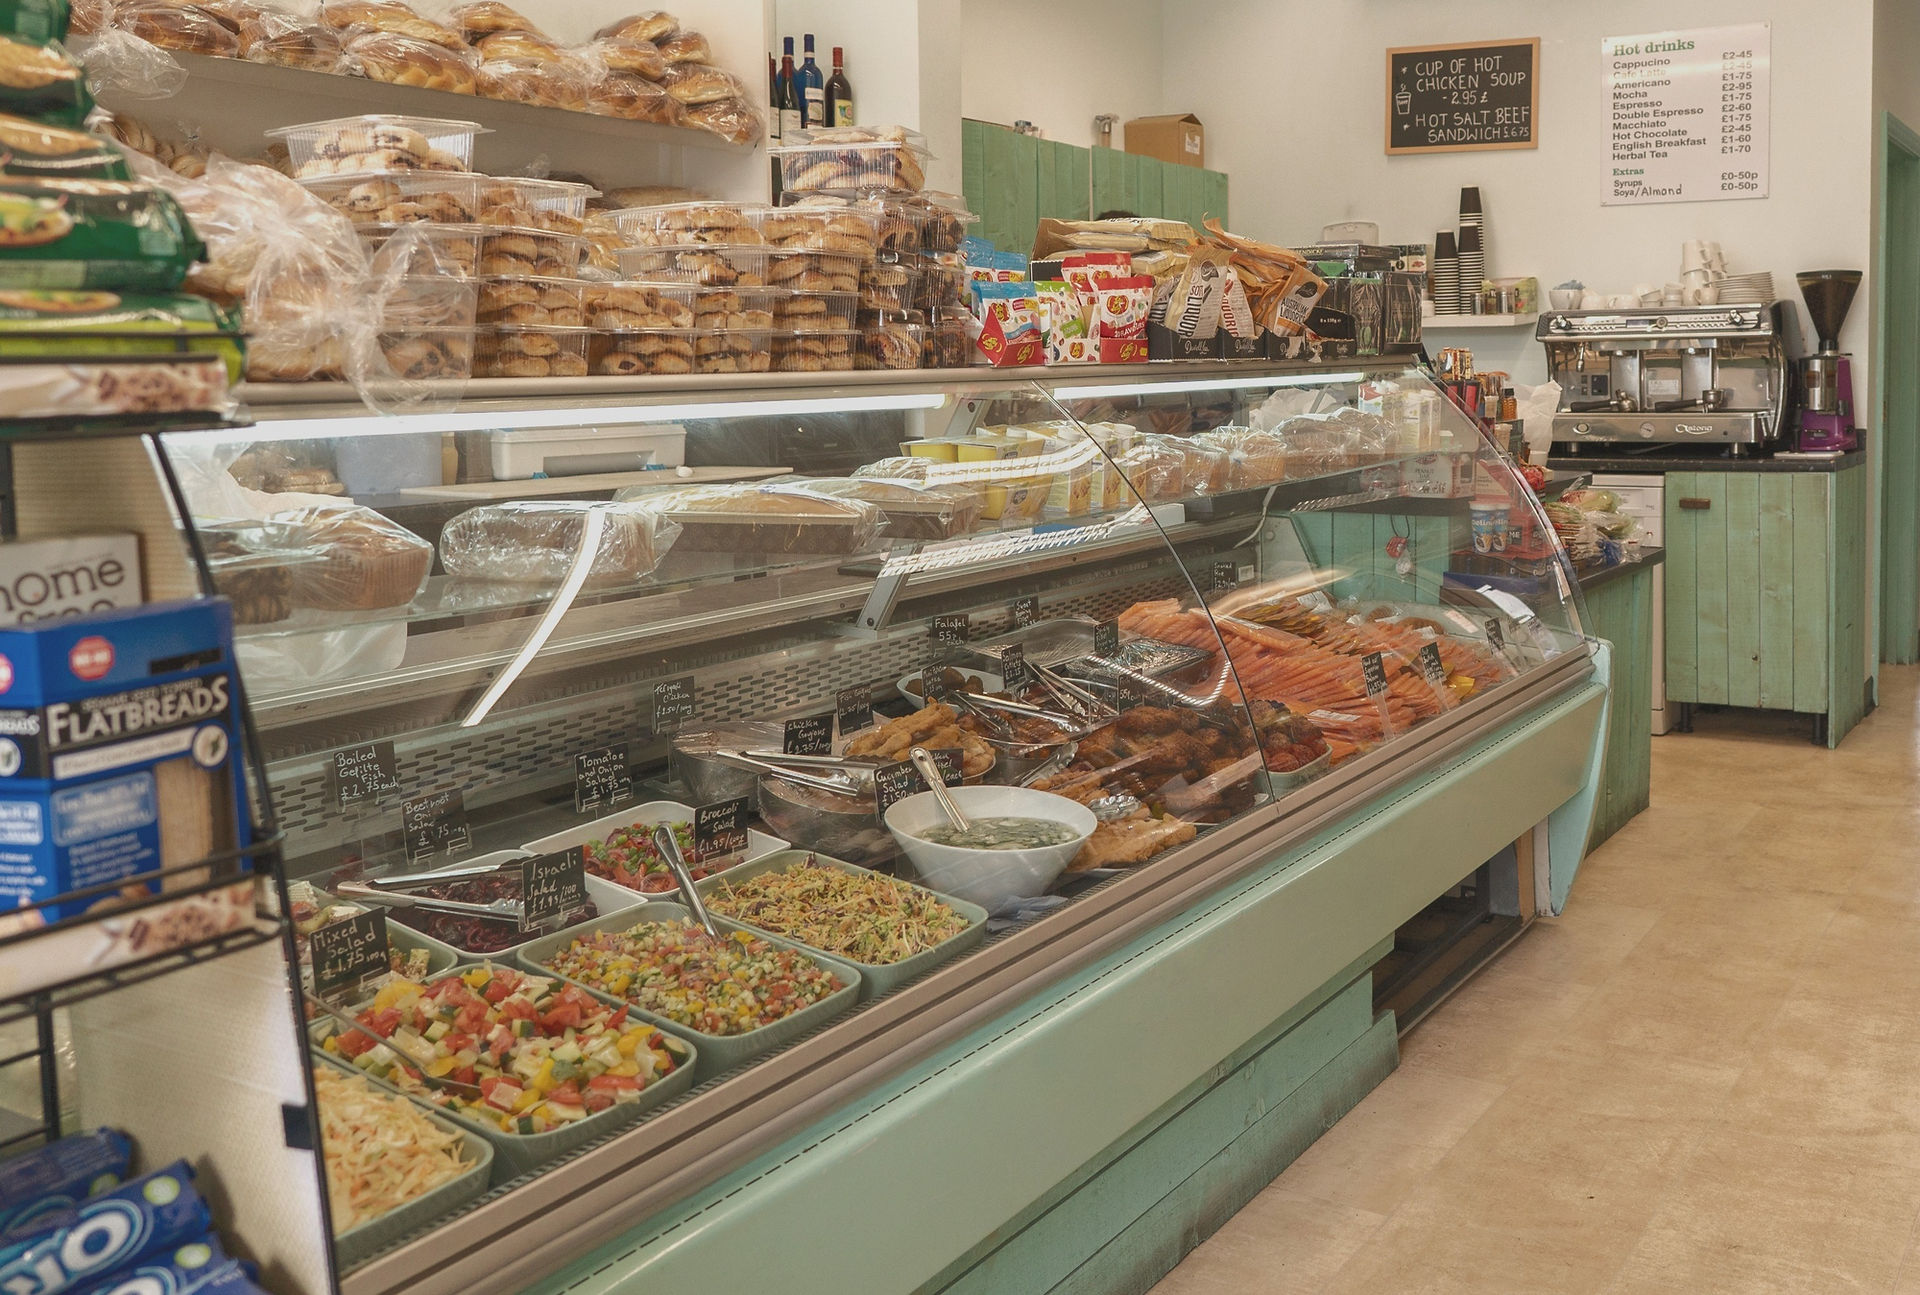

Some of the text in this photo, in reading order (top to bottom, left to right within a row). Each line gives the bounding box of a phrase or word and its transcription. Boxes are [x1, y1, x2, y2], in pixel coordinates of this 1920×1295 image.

[1613, 39, 1695, 57] Hot drinks
[1415, 56, 1502, 76] CUP OF HOT
[1613, 50, 1752, 70] Cappucino £2-45
[1416, 72, 1526, 92] CHICKEN SOUP
[1613, 71, 1752, 90] Americano £1-75
[1613, 82, 1752, 100] Mocha £2-95
[1613, 92, 1752, 111] Espresso £1-75
[1415, 106, 1530, 127] HOT SALT BEEF
[1613, 103, 1752, 120] Double Espresso £2-60
[1613, 113, 1752, 130] Macchiato £1-75
[1428, 126, 1501, 143] SANDWICH
[1613, 124, 1752, 141] Hot Chocolate £2-45
[1613, 134, 1752, 152] English Breakfast £1-60
[1613, 145, 1752, 160] Herbal Tea £1-70
[1613, 168, 1645, 176] Extras
[1614, 171, 1759, 189] Syrups £0-50p
[1721, 181, 1758, 192] £0-50p
[934, 618, 966, 631] Falafel
[47, 675, 228, 747] FLATBREADS
[335, 746, 377, 767] Boiled
[361, 771, 386, 784] Fish
[578, 763, 625, 781] and Onion
[586, 772, 616, 789] Salad
[883, 775, 909, 793] Salad
[700, 801, 740, 825] Broccoli
[713, 816, 736, 834] Salad
[530, 851, 578, 882] Israeli
[527, 879, 559, 902] Salad
[313, 920, 358, 951] Mixed
[328, 921, 376, 958] Salad
